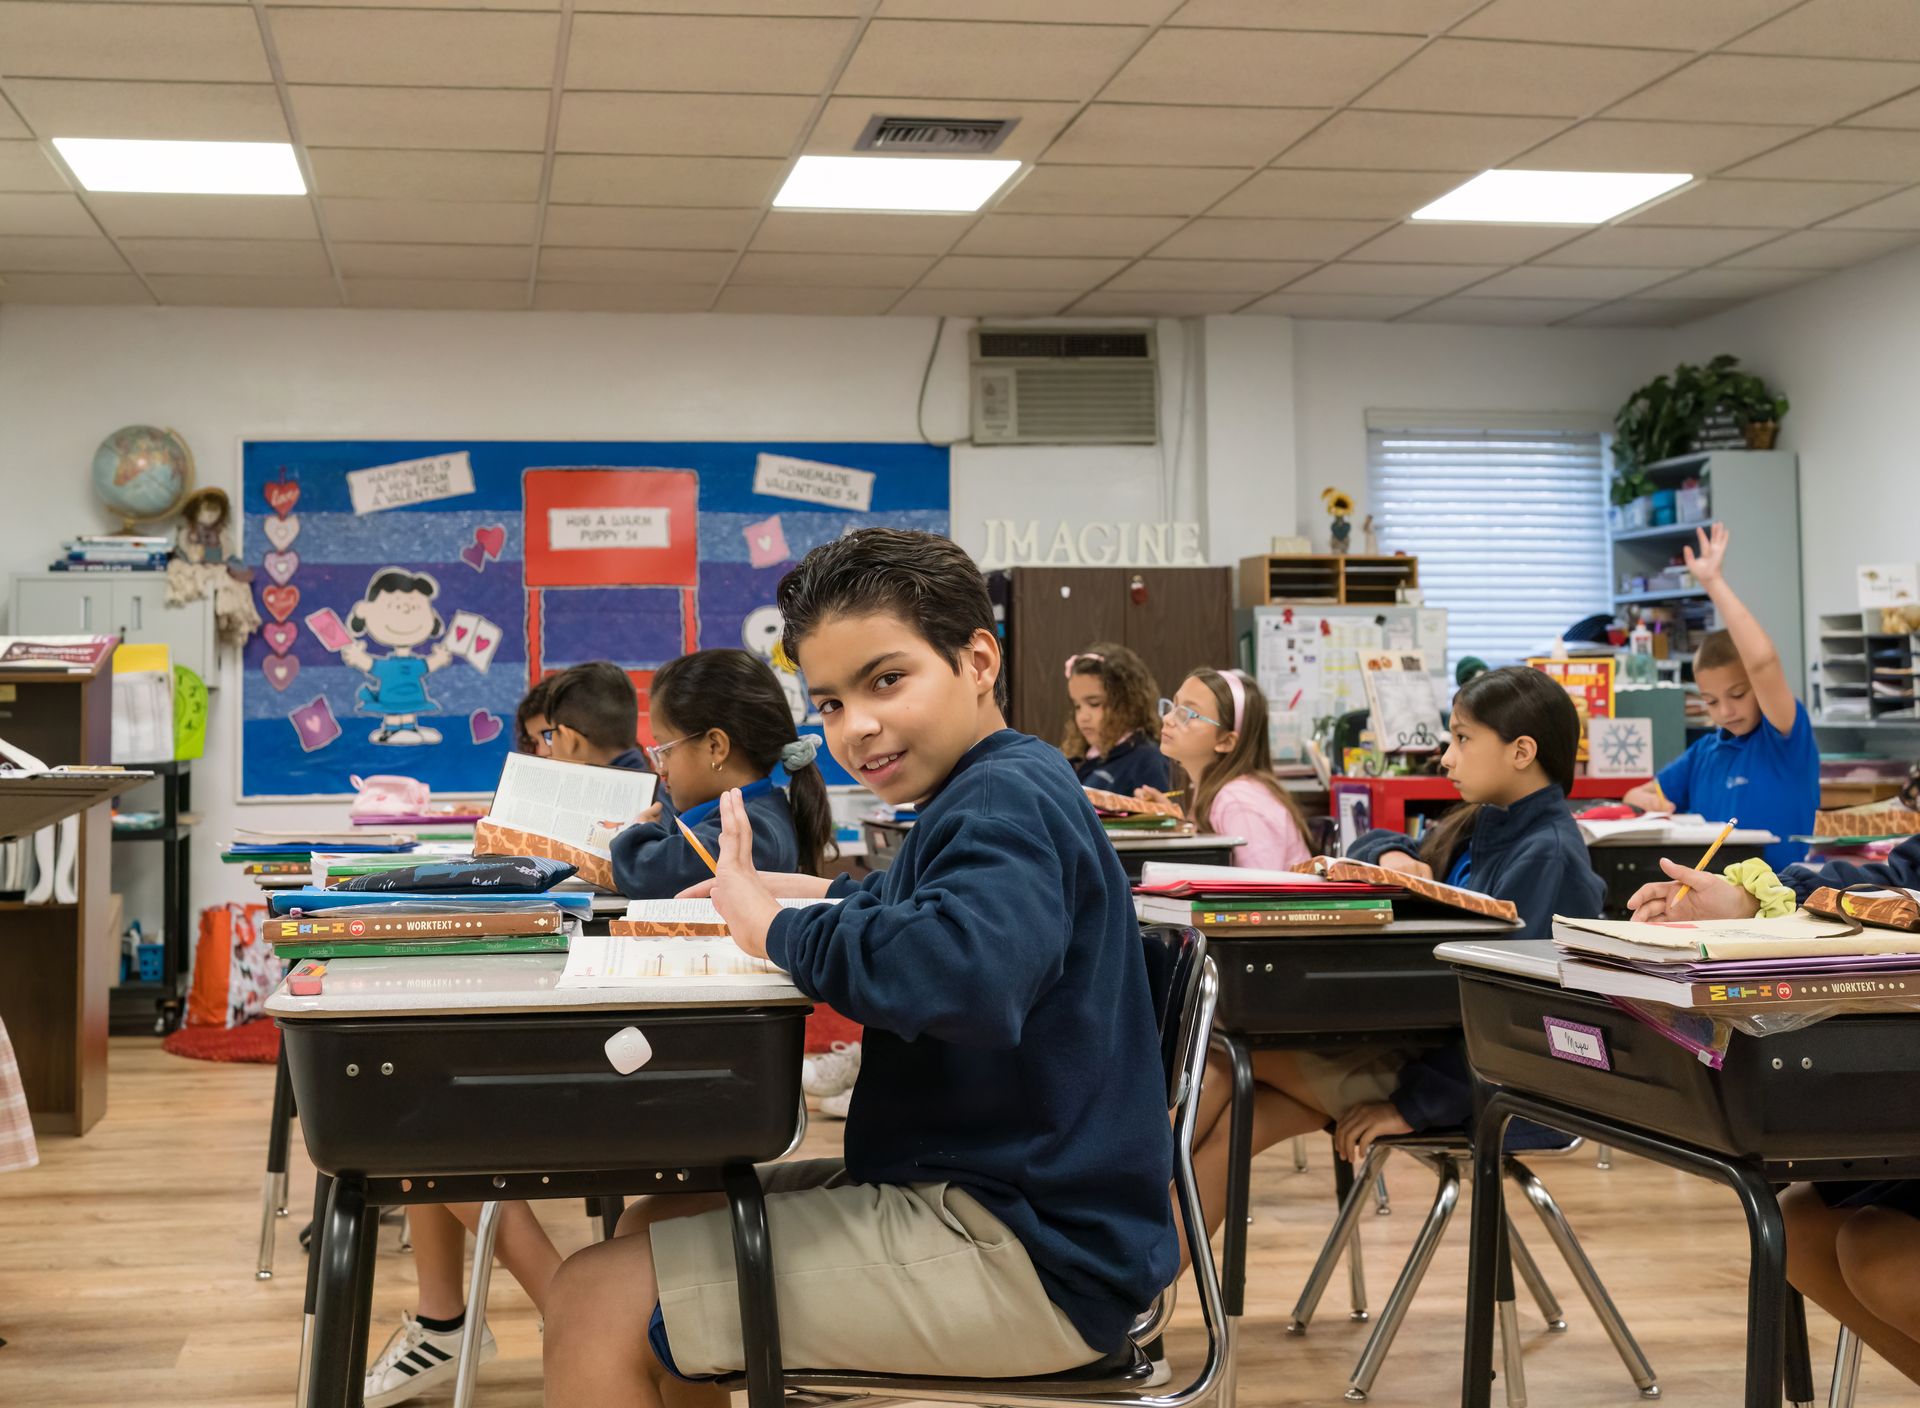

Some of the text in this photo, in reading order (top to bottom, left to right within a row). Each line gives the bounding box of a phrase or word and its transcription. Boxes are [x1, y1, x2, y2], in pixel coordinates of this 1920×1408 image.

[778, 466, 849, 486] HOMEMADE
[385, 483, 450, 503] VALENTINE
[764, 478, 842, 499] VALENTINES
[566, 514, 652, 526] HUG A WARM
[580, 530, 618, 541] PUPPY
[979, 519, 1209, 566] IMAGINE
[281, 922, 345, 936] MATH
[406, 920, 452, 930] WORKTEXT
[1709, 984, 1772, 1001] MATH
[1831, 981, 1876, 993] WORKTEXT
